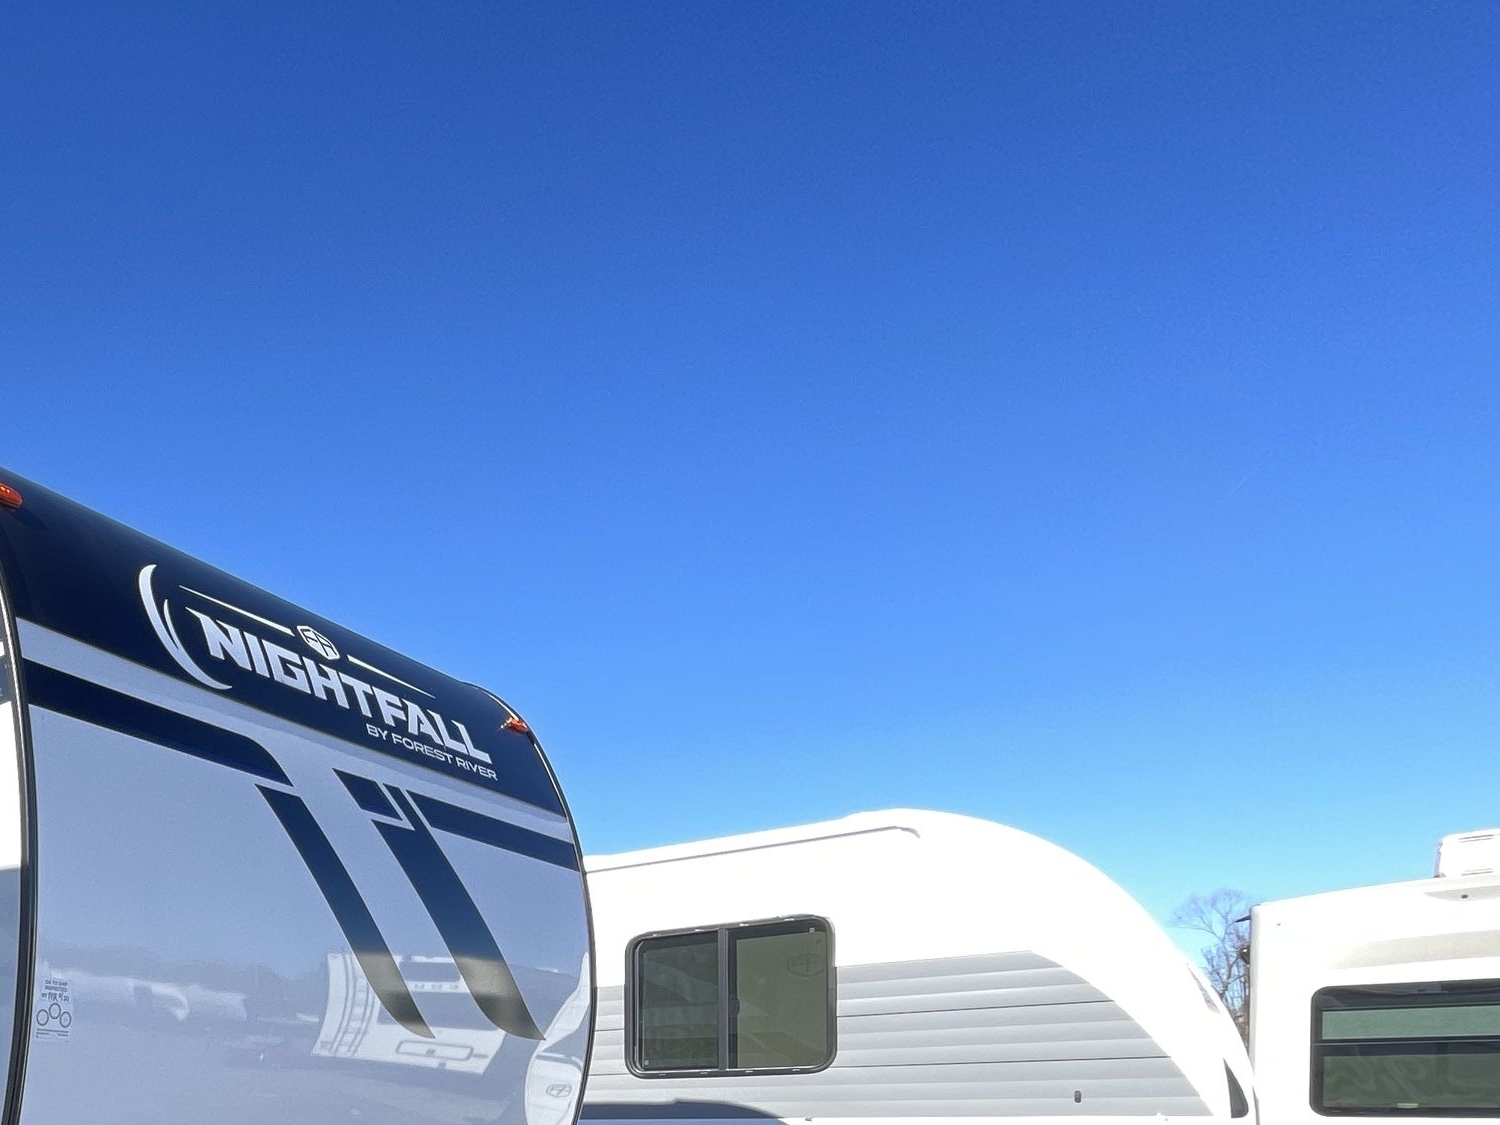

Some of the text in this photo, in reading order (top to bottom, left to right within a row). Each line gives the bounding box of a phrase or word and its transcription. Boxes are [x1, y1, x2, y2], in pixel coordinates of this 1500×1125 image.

[186, 607, 492, 765] NIGHTFALL
[366, 723, 498, 781] BY FOREST RIVER
